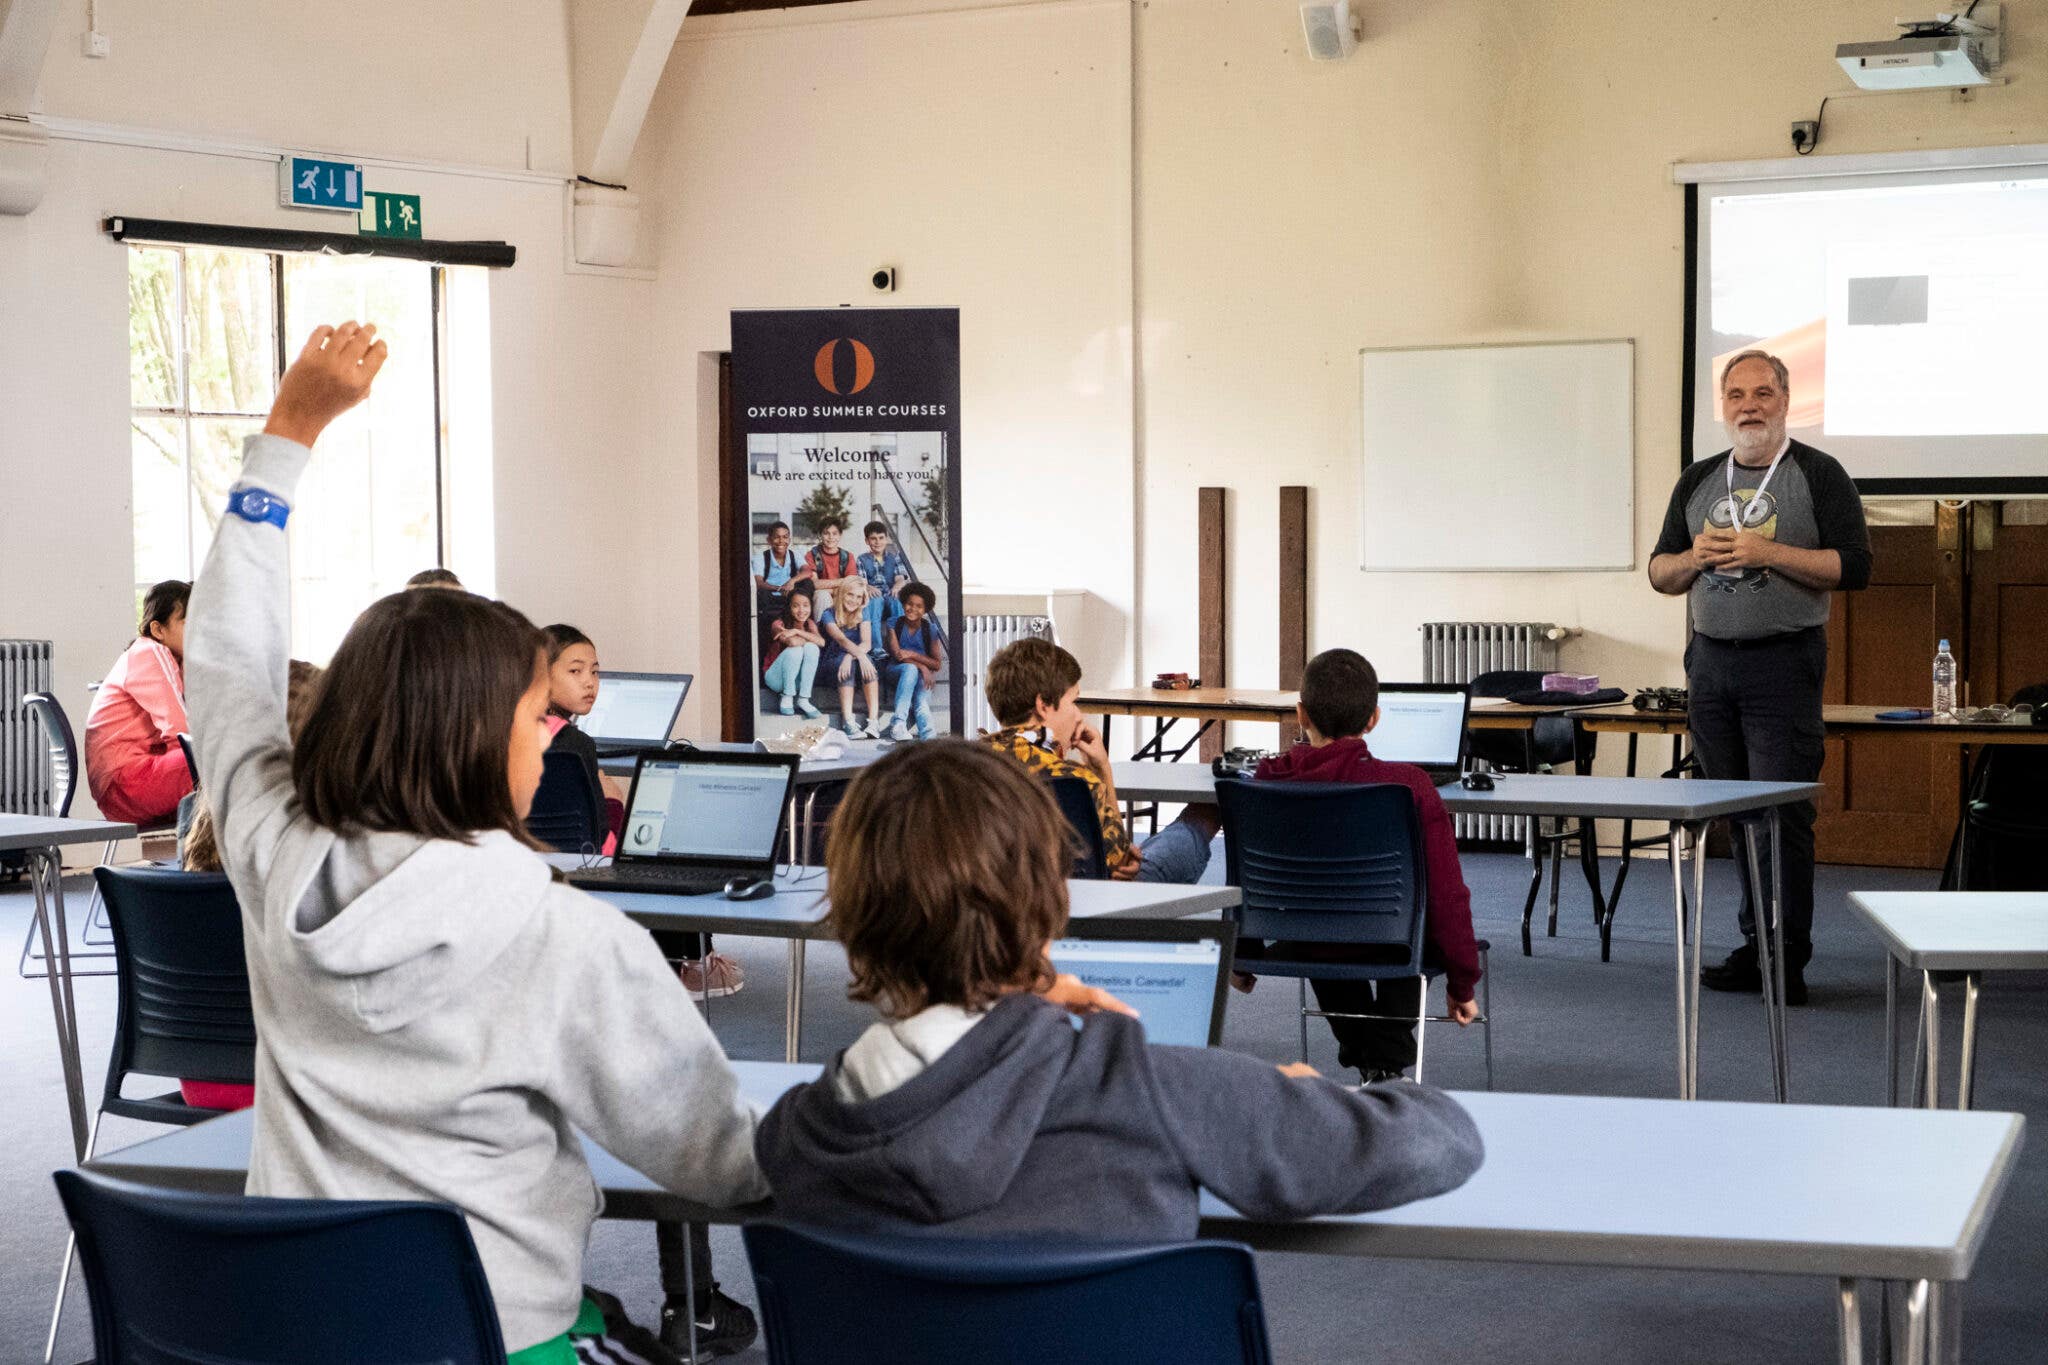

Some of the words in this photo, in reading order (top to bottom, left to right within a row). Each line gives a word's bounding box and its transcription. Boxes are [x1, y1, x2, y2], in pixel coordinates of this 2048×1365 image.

[747, 406, 808, 418] OXFORD
[813, 405, 874, 417] SUMMER
[878, 404, 947, 416] COURSES
[804, 447, 890, 463] Welcome
[761, 470, 781, 481] We
[784, 472, 804, 481] are
[808, 469, 853, 481] excited
[857, 470, 870, 480] to
[872, 469, 903, 480] have
[906, 469, 934, 484] you!
